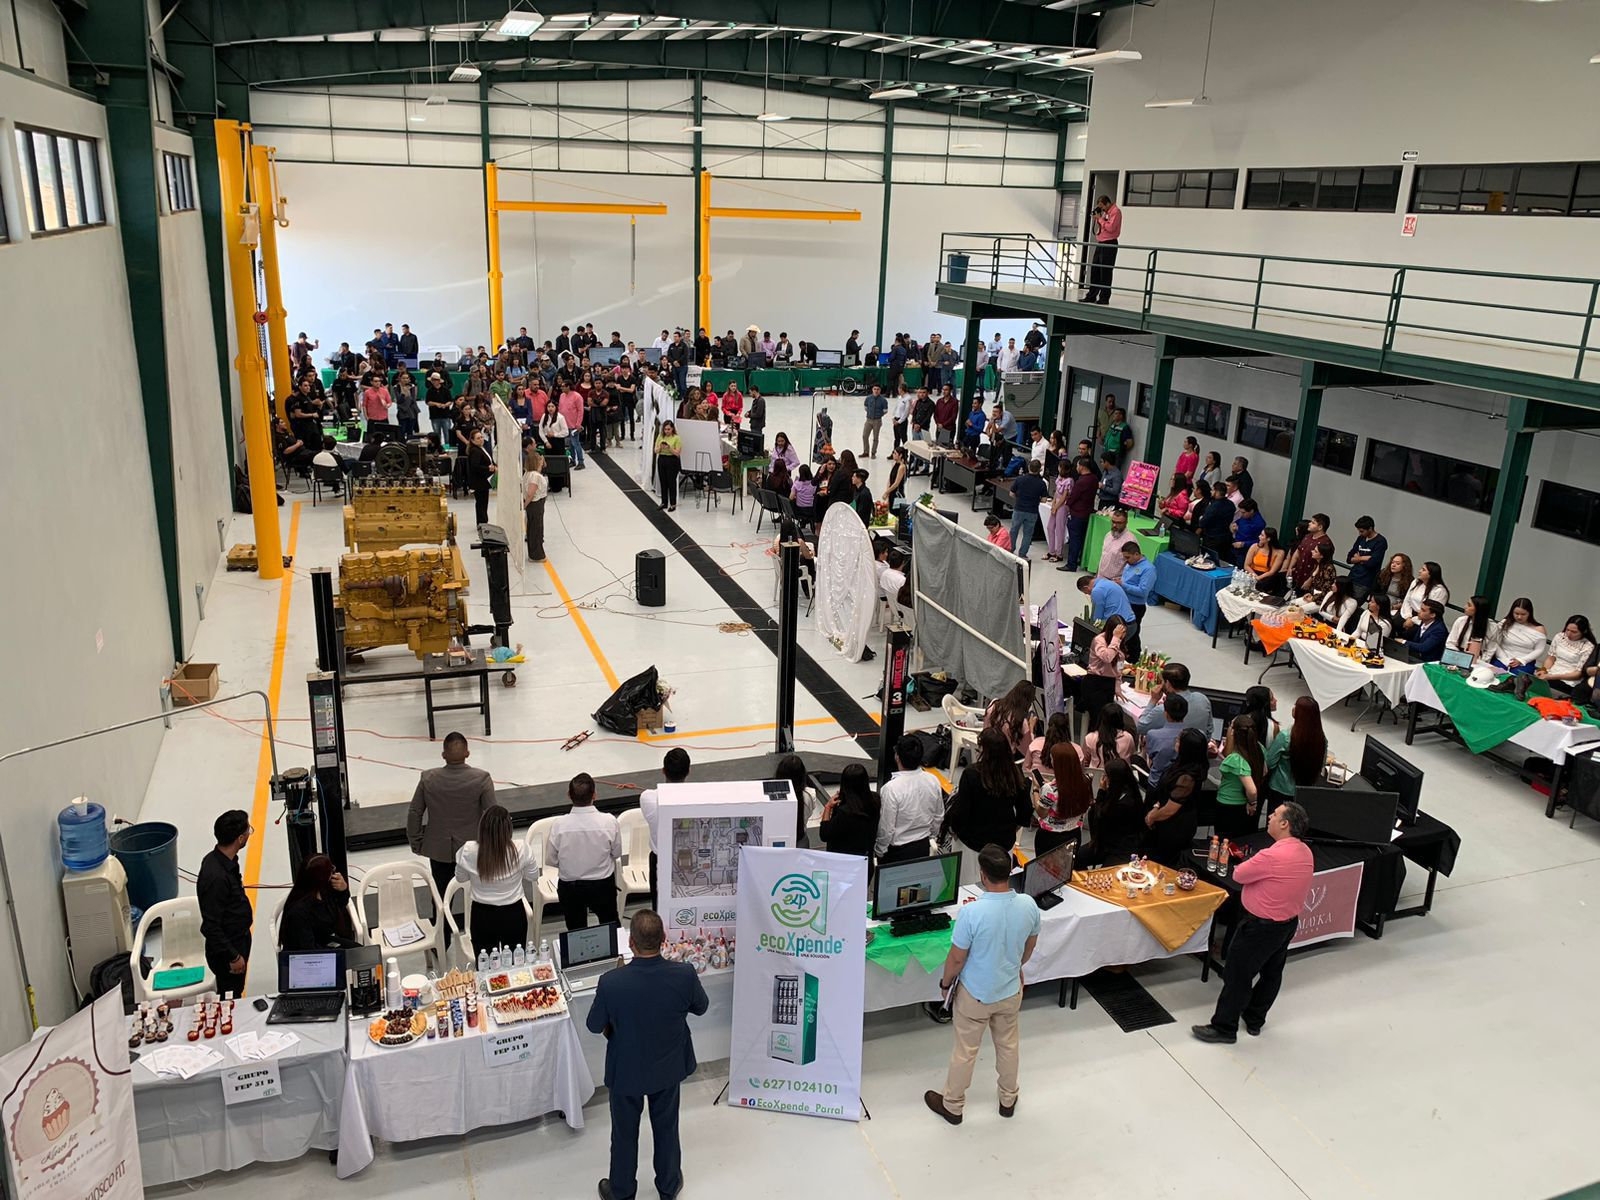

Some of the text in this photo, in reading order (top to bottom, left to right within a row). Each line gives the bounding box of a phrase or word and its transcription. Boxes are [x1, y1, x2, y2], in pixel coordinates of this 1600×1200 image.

[703, 910, 736, 921] ecoXpe
[760, 931, 843, 957] ecoXpende
[496, 1034, 524, 1045] GRUPO
[237, 1070, 269, 1080] GRUPO
[234, 1083, 252, 1091] FEP
[762, 1078, 838, 1095] 6271024101
[757, 1098, 844, 1115] EcoXpende_Parral
